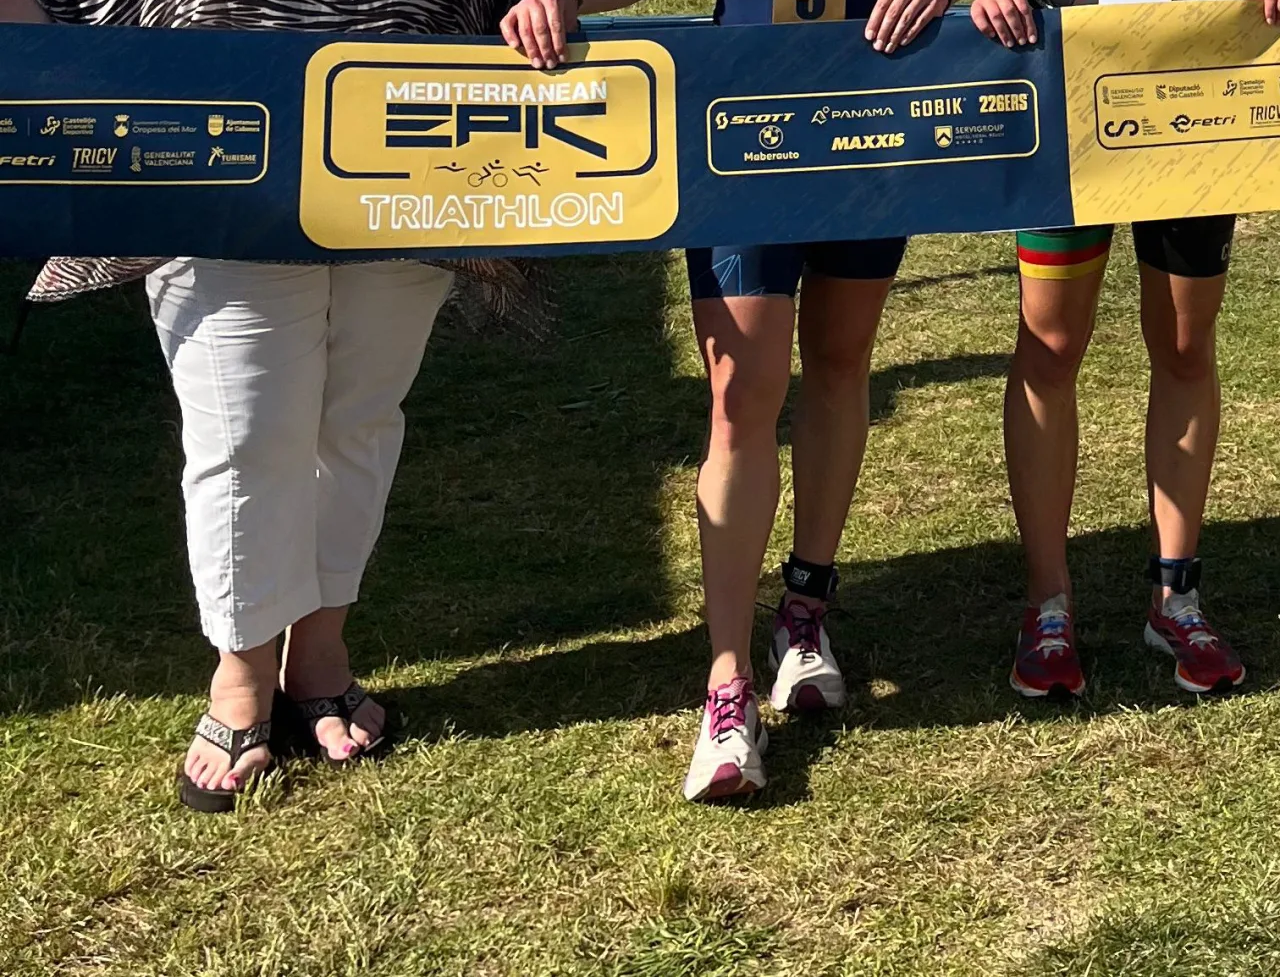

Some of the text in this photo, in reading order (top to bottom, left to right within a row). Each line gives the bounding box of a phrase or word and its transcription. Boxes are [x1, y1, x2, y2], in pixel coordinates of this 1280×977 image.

[385, 81, 608, 102] MEDITERRANEAN
[1169, 84, 1200, 93] Diputació
[910, 98, 963, 118] GOBIK
[979, 93, 1029, 113] 226ERS
[730, 113, 796, 125] SCOTT
[831, 107, 894, 119] PANAMA
[132, 126, 166, 134] Oropesa
[832, 133, 905, 151] MAXXIS
[72, 148, 118, 168] TRICV
[144, 151, 196, 159] GENERALITAT
[221, 154, 257, 162] TURISME
[744, 151, 799, 161] Maberauto
[360, 191, 624, 230] TRIATHLON
